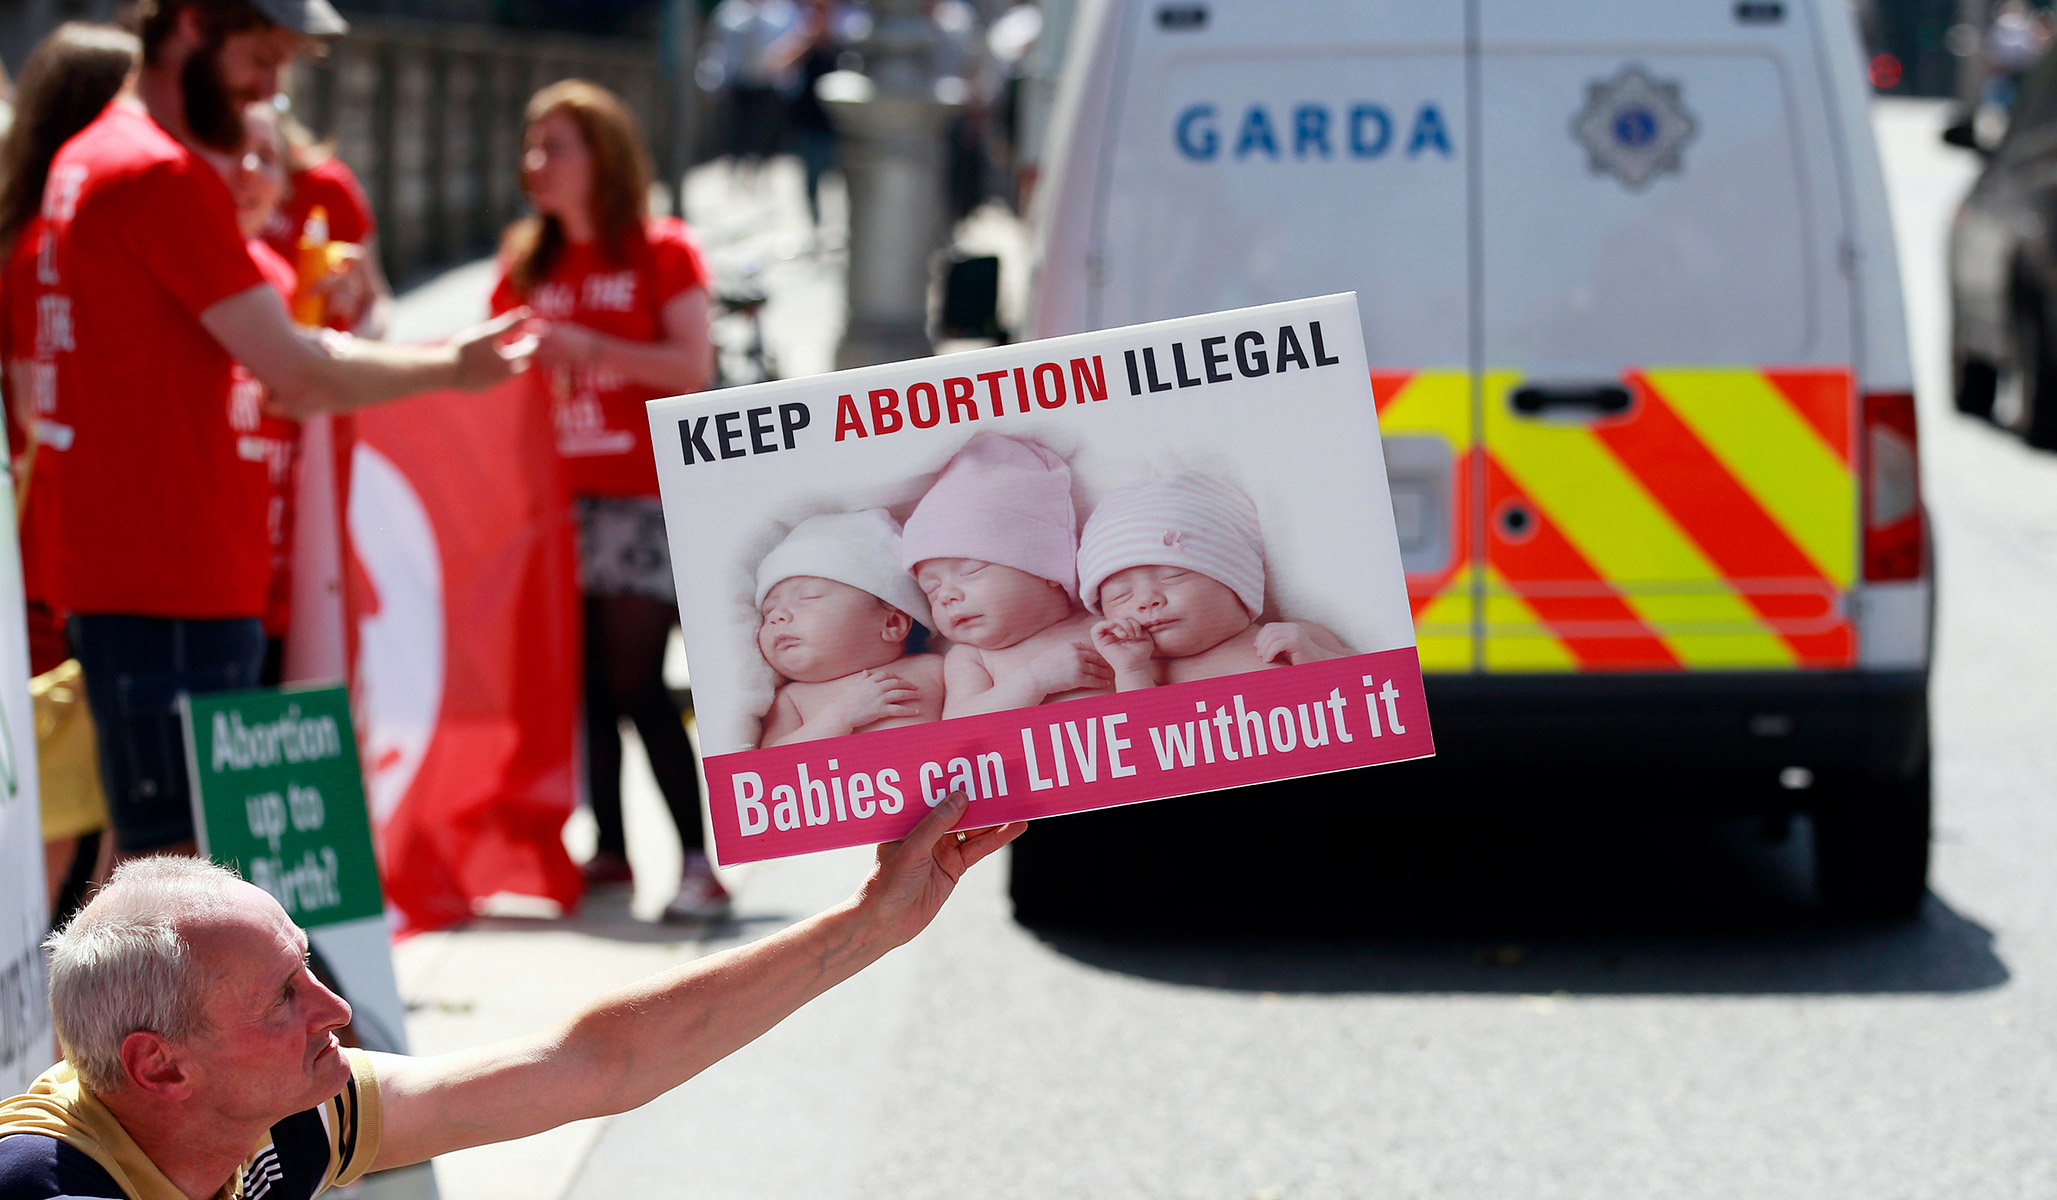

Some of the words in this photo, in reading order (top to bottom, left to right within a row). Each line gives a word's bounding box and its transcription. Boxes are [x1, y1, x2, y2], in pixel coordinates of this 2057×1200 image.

[1173, 101, 1456, 161] GARDA
[677, 402, 811, 466] KEEP
[834, 355, 1108, 442] ABORTION
[1124, 320, 1339, 396] ILLEGAL
[211, 703, 341, 772] Abortion
[731, 758, 904, 837] Babies
[919, 750, 1008, 808] can
[1021, 712, 1137, 792] LIVE
[1148, 687, 1353, 771] without
[1362, 674, 1406, 738] it
[246, 791, 287, 853] up
[287, 781, 325, 832] to
